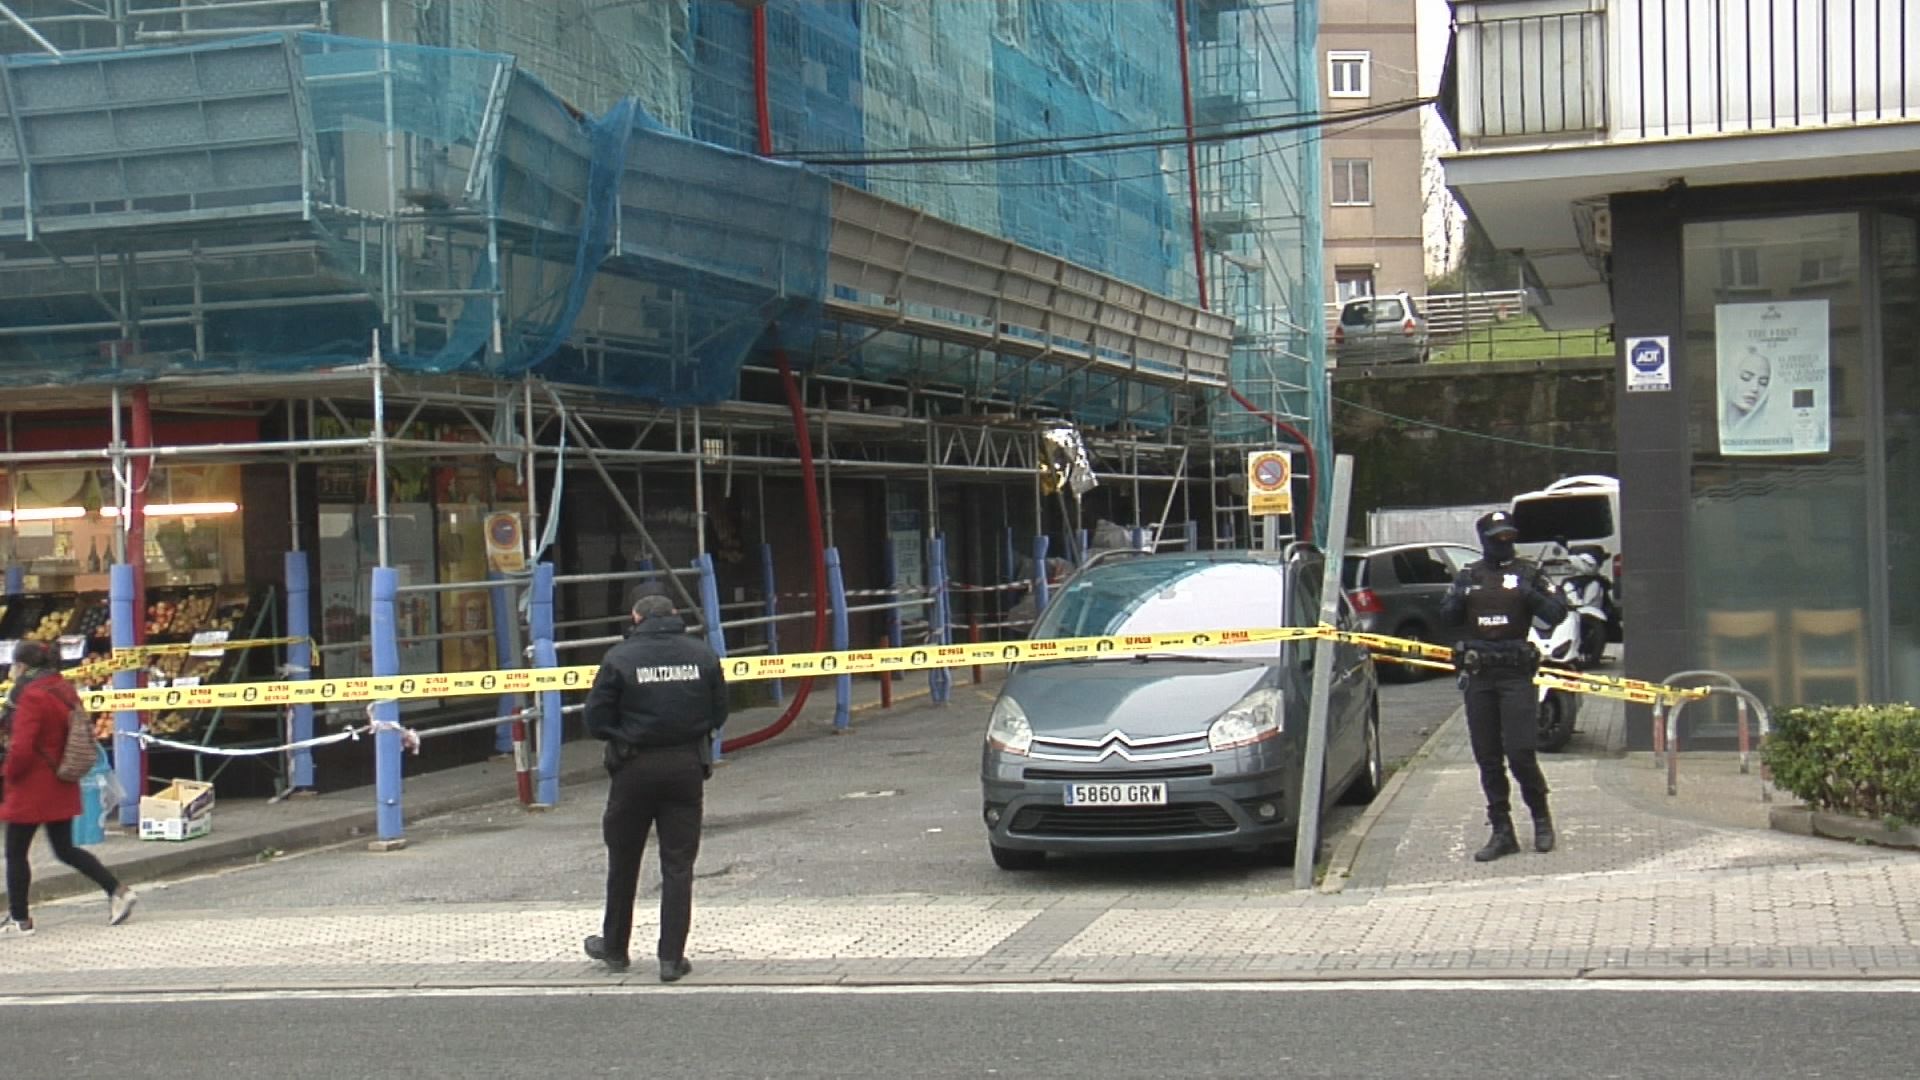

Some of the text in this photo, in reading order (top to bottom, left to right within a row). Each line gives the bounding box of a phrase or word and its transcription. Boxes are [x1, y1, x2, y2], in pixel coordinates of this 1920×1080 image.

[1636, 350, 1659, 363] ADT
[1076, 785, 1161, 802] 5860 GRW
